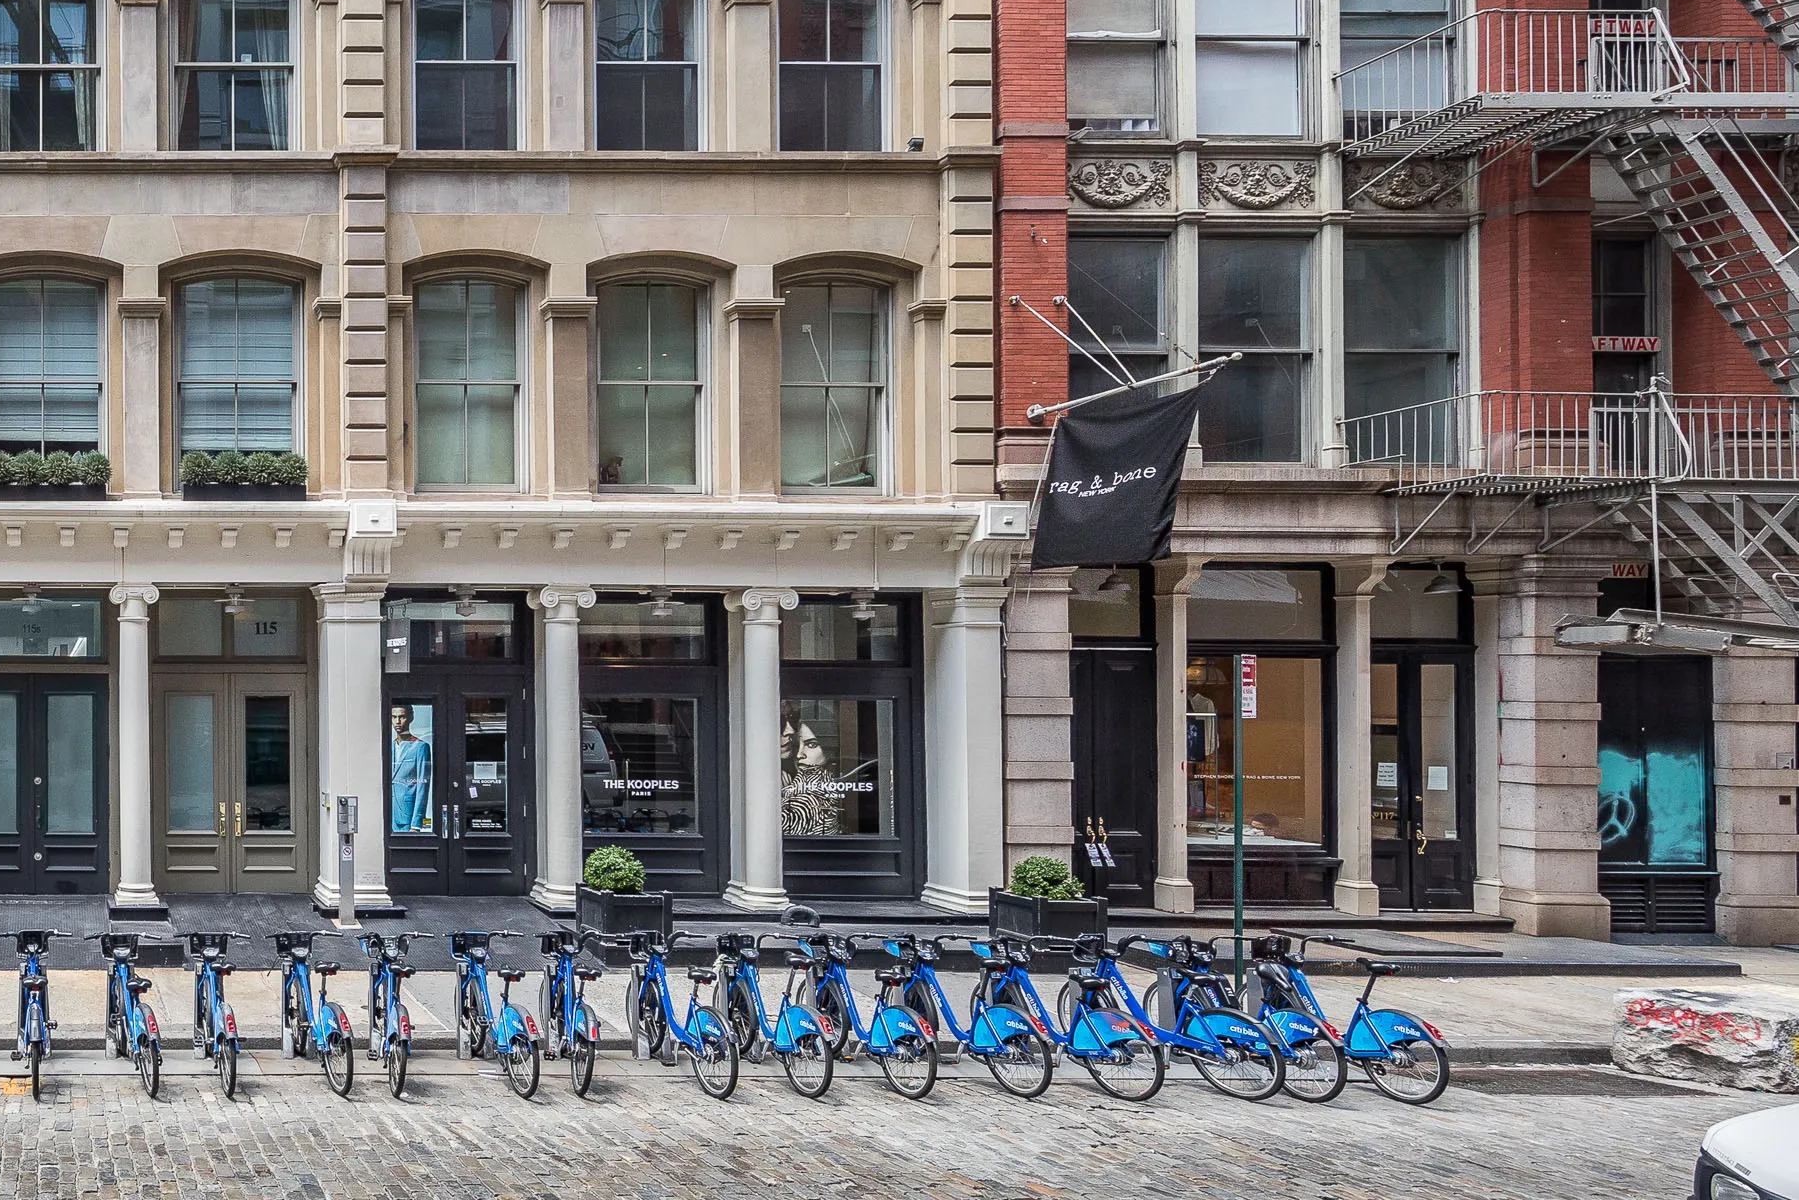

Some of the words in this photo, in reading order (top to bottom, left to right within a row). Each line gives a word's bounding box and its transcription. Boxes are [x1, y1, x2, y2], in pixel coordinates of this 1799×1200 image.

[1049, 480, 1082, 494] rag
[1090, 475, 1102, 489] &
[1112, 466, 1157, 486] bone
[1078, 490, 1097, 498] NEW
[255, 621, 278, 635] 115
[603, 780, 625, 789] THE
[627, 780, 679, 789] KOOPLES
[821, 782, 874, 791] KOOPLES
